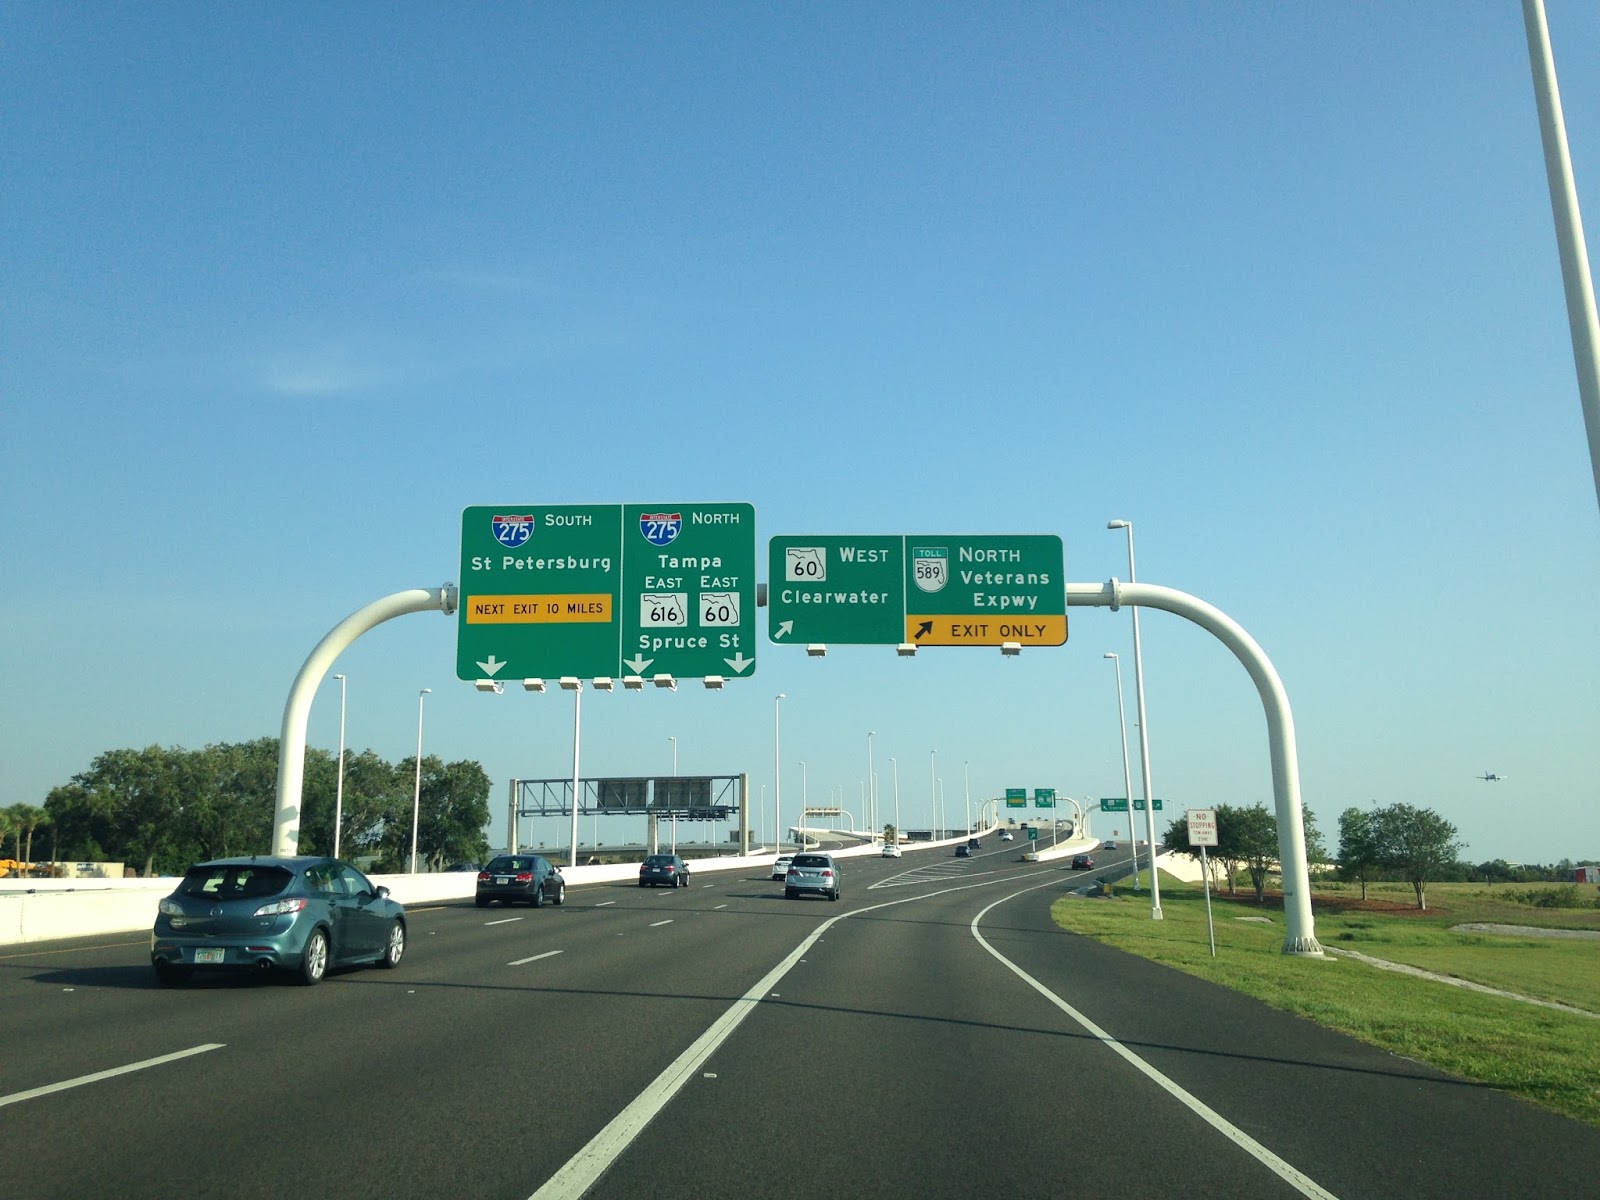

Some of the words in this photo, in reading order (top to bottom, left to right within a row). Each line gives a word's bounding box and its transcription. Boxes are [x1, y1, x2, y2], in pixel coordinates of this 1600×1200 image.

[545, 514, 592, 526] SOUTH
[692, 512, 740, 525] NORTH
[499, 522, 530, 541] 275
[646, 521, 678, 539] 275
[839, 547, 889, 562] WEST
[959, 547, 1021, 562] NORTH
[471, 557, 492, 571] St
[503, 556, 611, 572] Petersburg
[658, 555, 722, 571] Tampa
[794, 561, 817, 576] 60
[917, 567, 940, 579] 589
[960, 570, 1050, 585] Veterans
[645, 576, 683, 589] EAST
[700, 575, 739, 588] EAST
[781, 590, 888, 604] Clearwater
[973, 593, 1038, 610] Expwy
[475, 604, 505, 615] NEXT
[513, 603, 537, 615] EXIT
[547, 603, 559, 614] 10
[567, 602, 603, 614] MILES
[650, 607, 678, 622] 616
[705, 606, 730, 622] 60
[951, 625, 989, 637] EXIT
[1000, 625, 1046, 637] ONLY
[639, 635, 708, 652] Spruce
[719, 633, 740, 648] St
